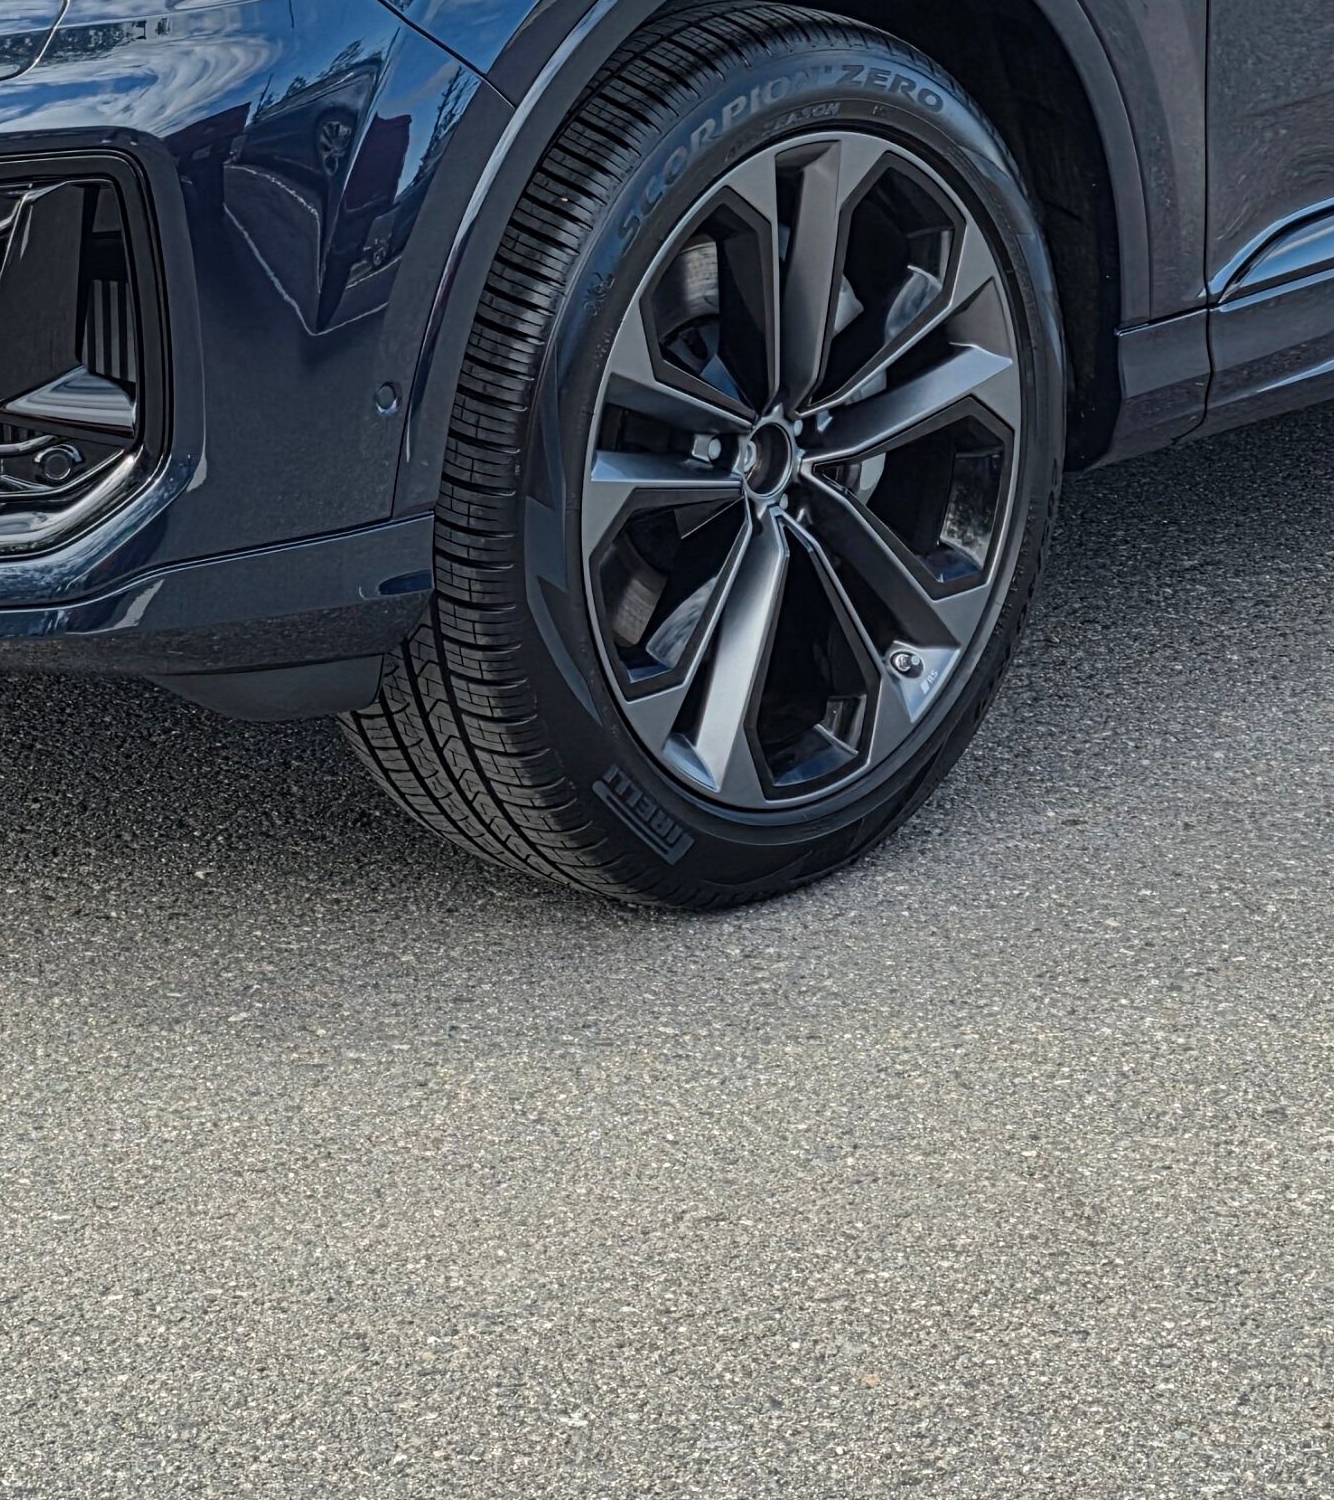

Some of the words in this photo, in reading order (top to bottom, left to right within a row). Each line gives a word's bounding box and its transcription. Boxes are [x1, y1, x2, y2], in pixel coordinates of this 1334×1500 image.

[617, 69, 813, 258] SCORPION
[835, 64, 944, 114] ZERO
[592, 763, 695, 866] PIRELLI
